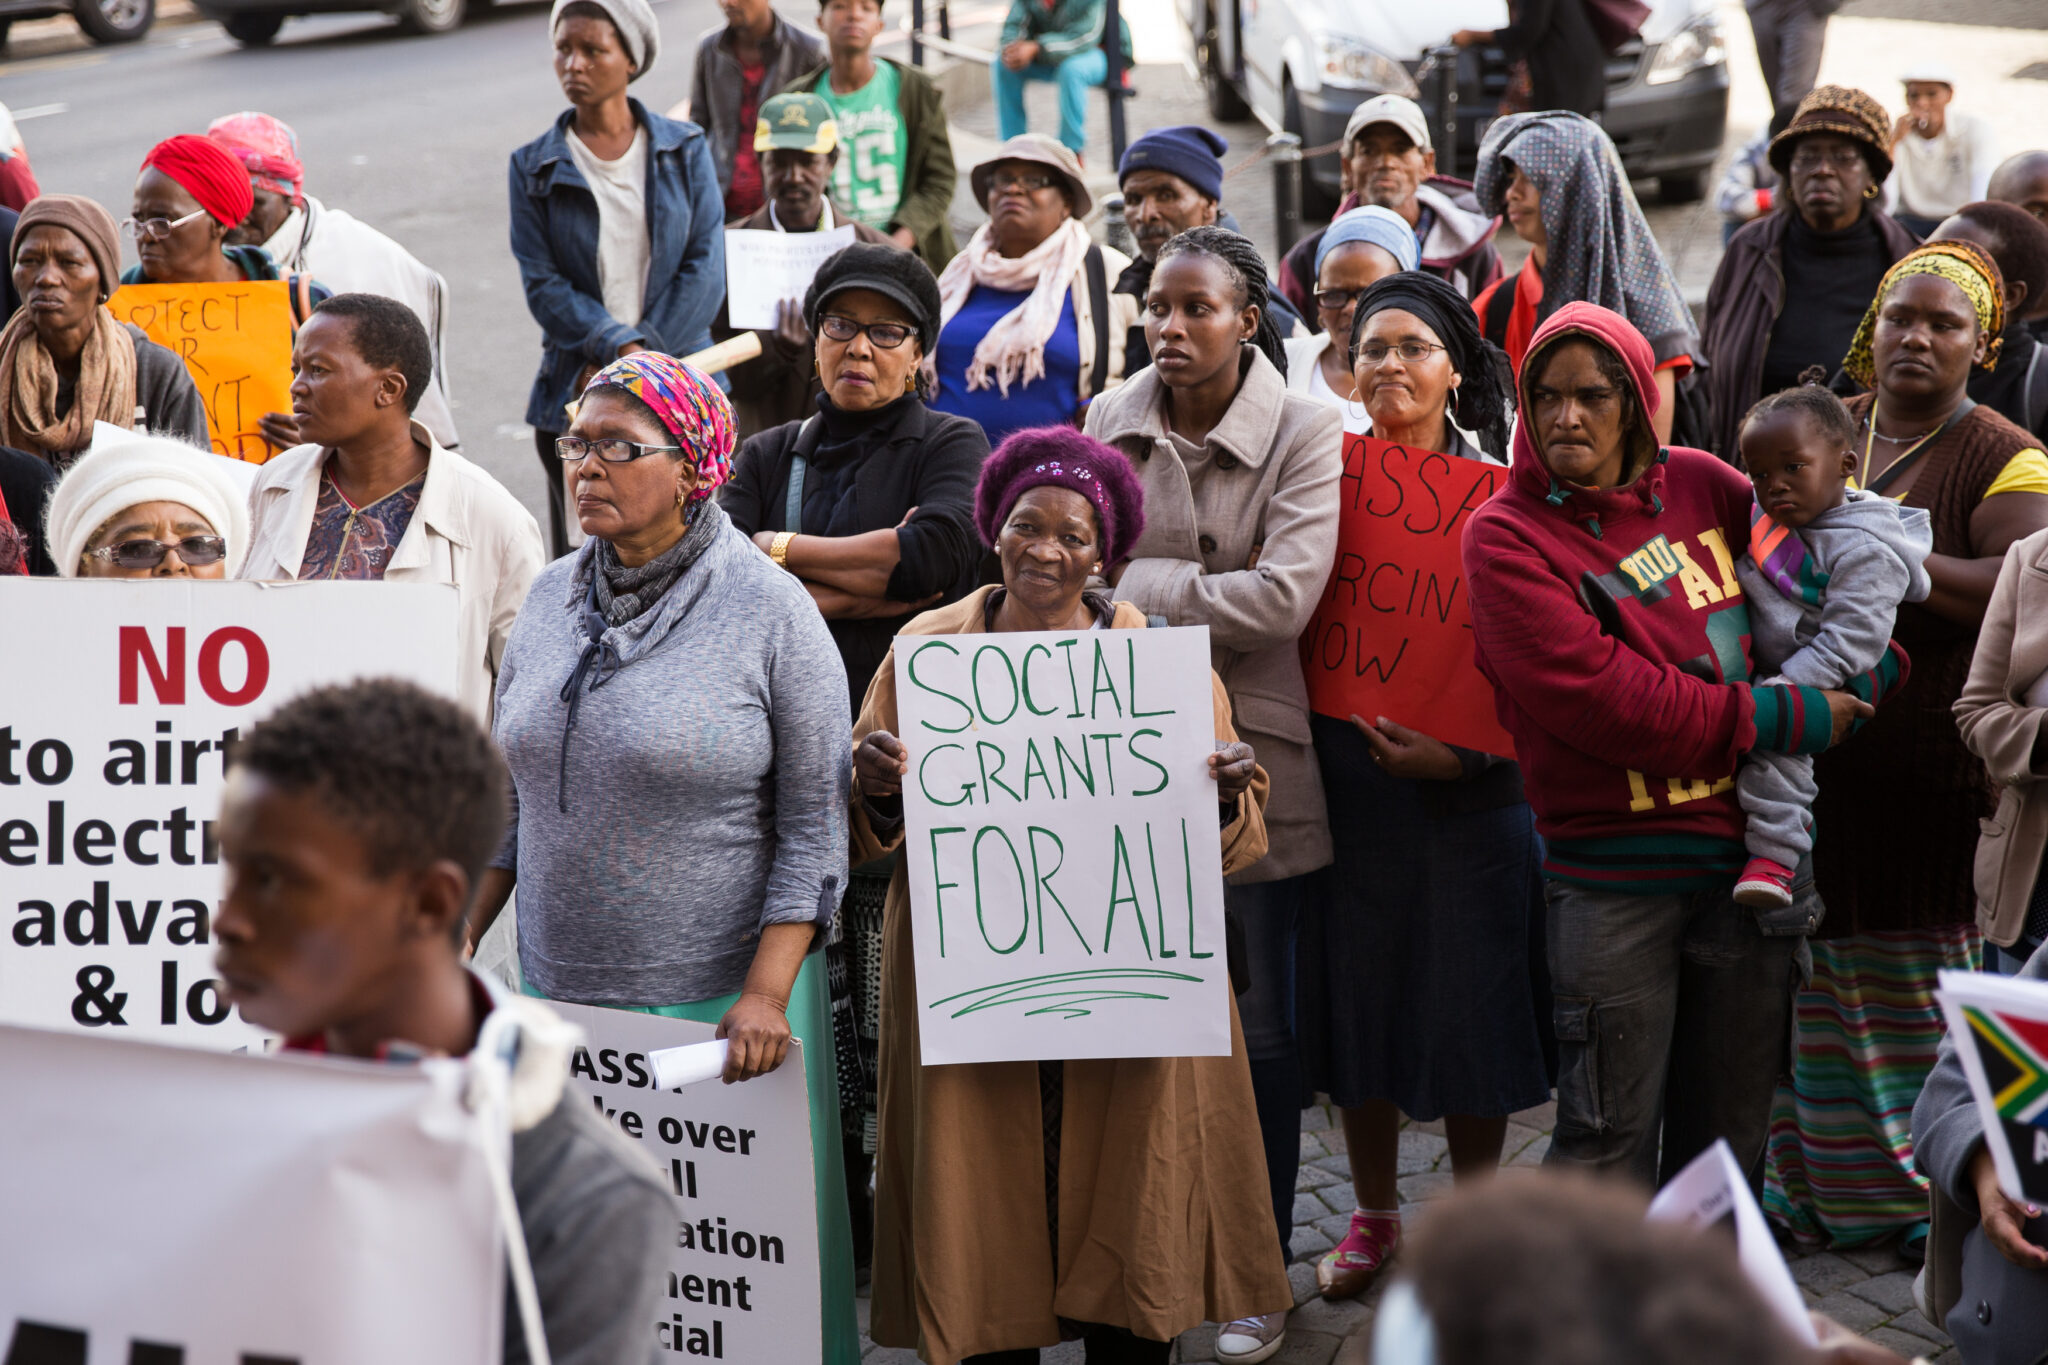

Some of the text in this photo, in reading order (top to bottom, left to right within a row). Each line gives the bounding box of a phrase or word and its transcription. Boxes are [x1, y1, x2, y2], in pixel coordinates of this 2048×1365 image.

[112, 293, 249, 333] OTECT
[1341, 439, 1495, 536] ASSA
[1333, 552, 1472, 629] RCIN
[1619, 535, 1677, 592] YOU
[118, 625, 270, 707] NO
[908, 638, 1176, 734] SOCIAL
[0, 720, 256, 786] to airt
[919, 728, 1169, 806] GRANTS
[12, 881, 224, 947] adva
[930, 817, 1214, 961] FOR ALL
[71, 960, 248, 1027] & lo
[569, 1045, 683, 1095] ASS
[657, 1117, 756, 1156] over
[660, 1158, 698, 1199] ll
[677, 1216, 785, 1265] ation
